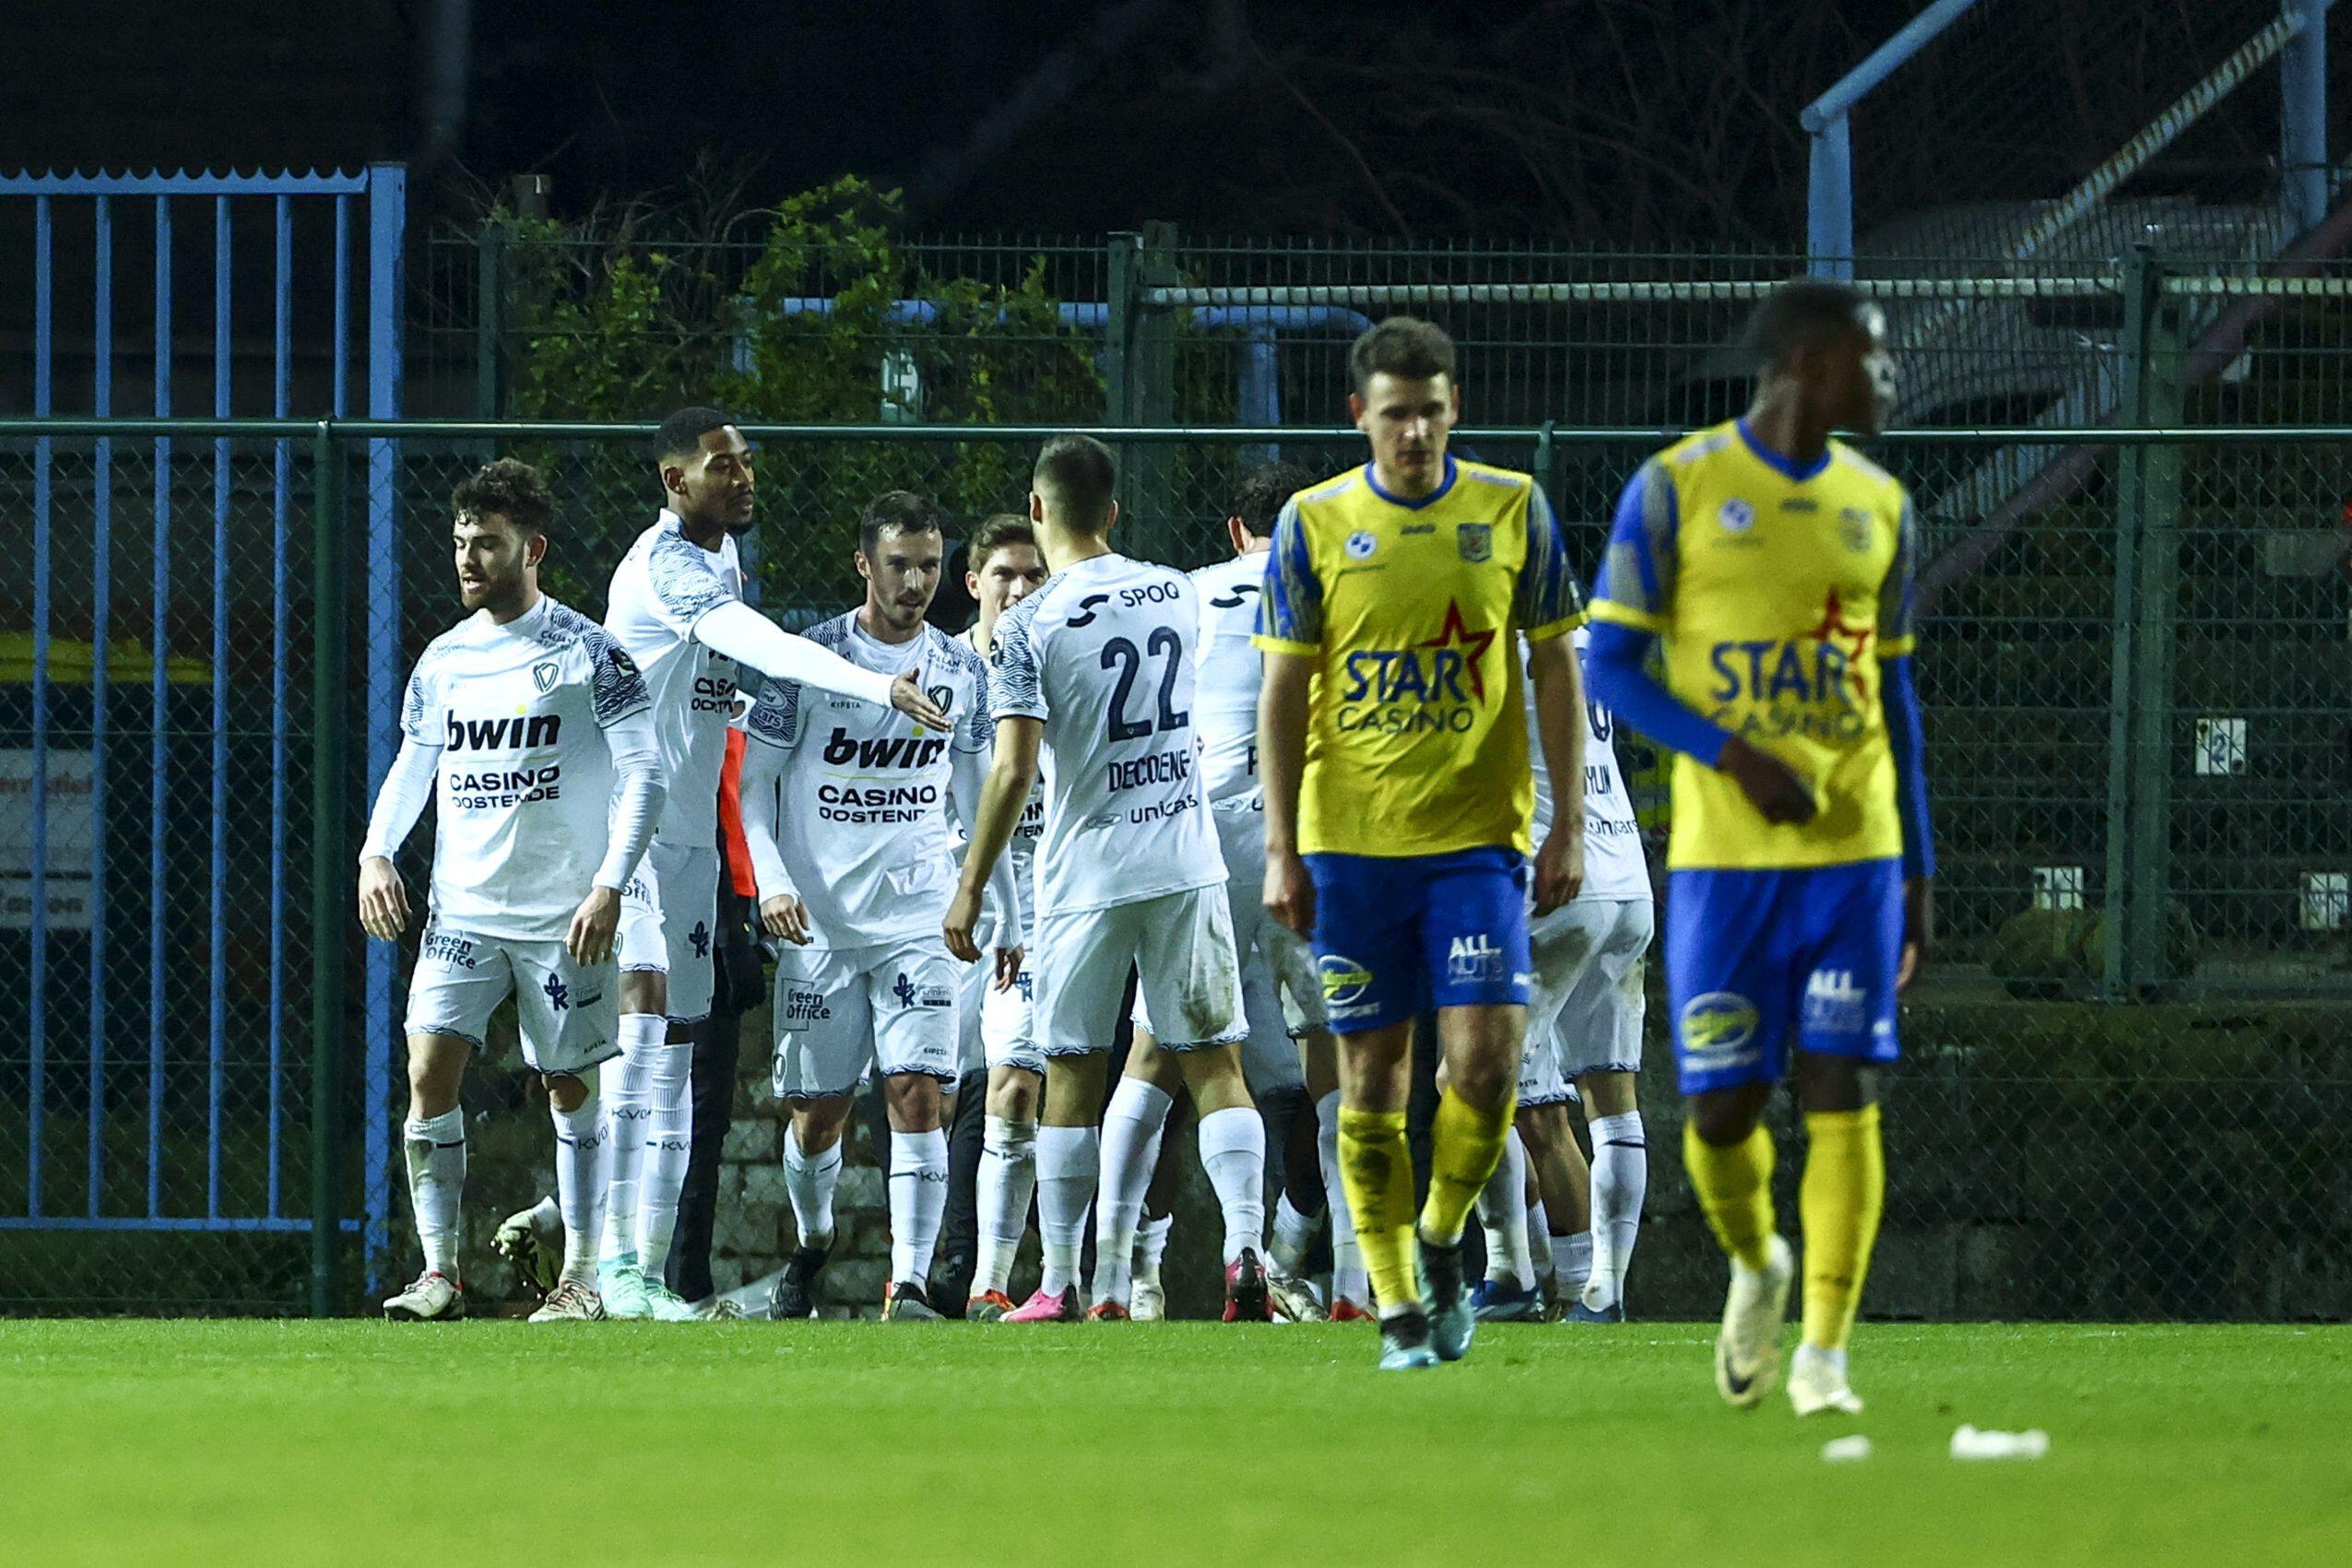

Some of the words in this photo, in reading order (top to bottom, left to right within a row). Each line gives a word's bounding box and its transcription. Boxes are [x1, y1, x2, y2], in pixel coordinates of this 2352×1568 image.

[1119, 582, 1180, 607] SPOQ
[1343, 649, 1468, 702] STAR
[1713, 640, 1853, 703] STAR
[1100, 626, 1189, 743] 22
[446, 704, 561, 752] bwin
[1338, 706, 1473, 734] CASINO
[823, 725, 947, 769] bwin
[450, 766, 561, 792] CASINO
[451, 785, 561, 809] OOSTENDE
[818, 784, 938, 808] CASINO
[426, 932, 472, 952] Green
[1448, 933, 1503, 959] ALL
[425, 946, 476, 970] Office
[787, 988, 823, 1006] Green
[786, 1003, 831, 1020] Office
[661, 1139, 691, 1151] KV
